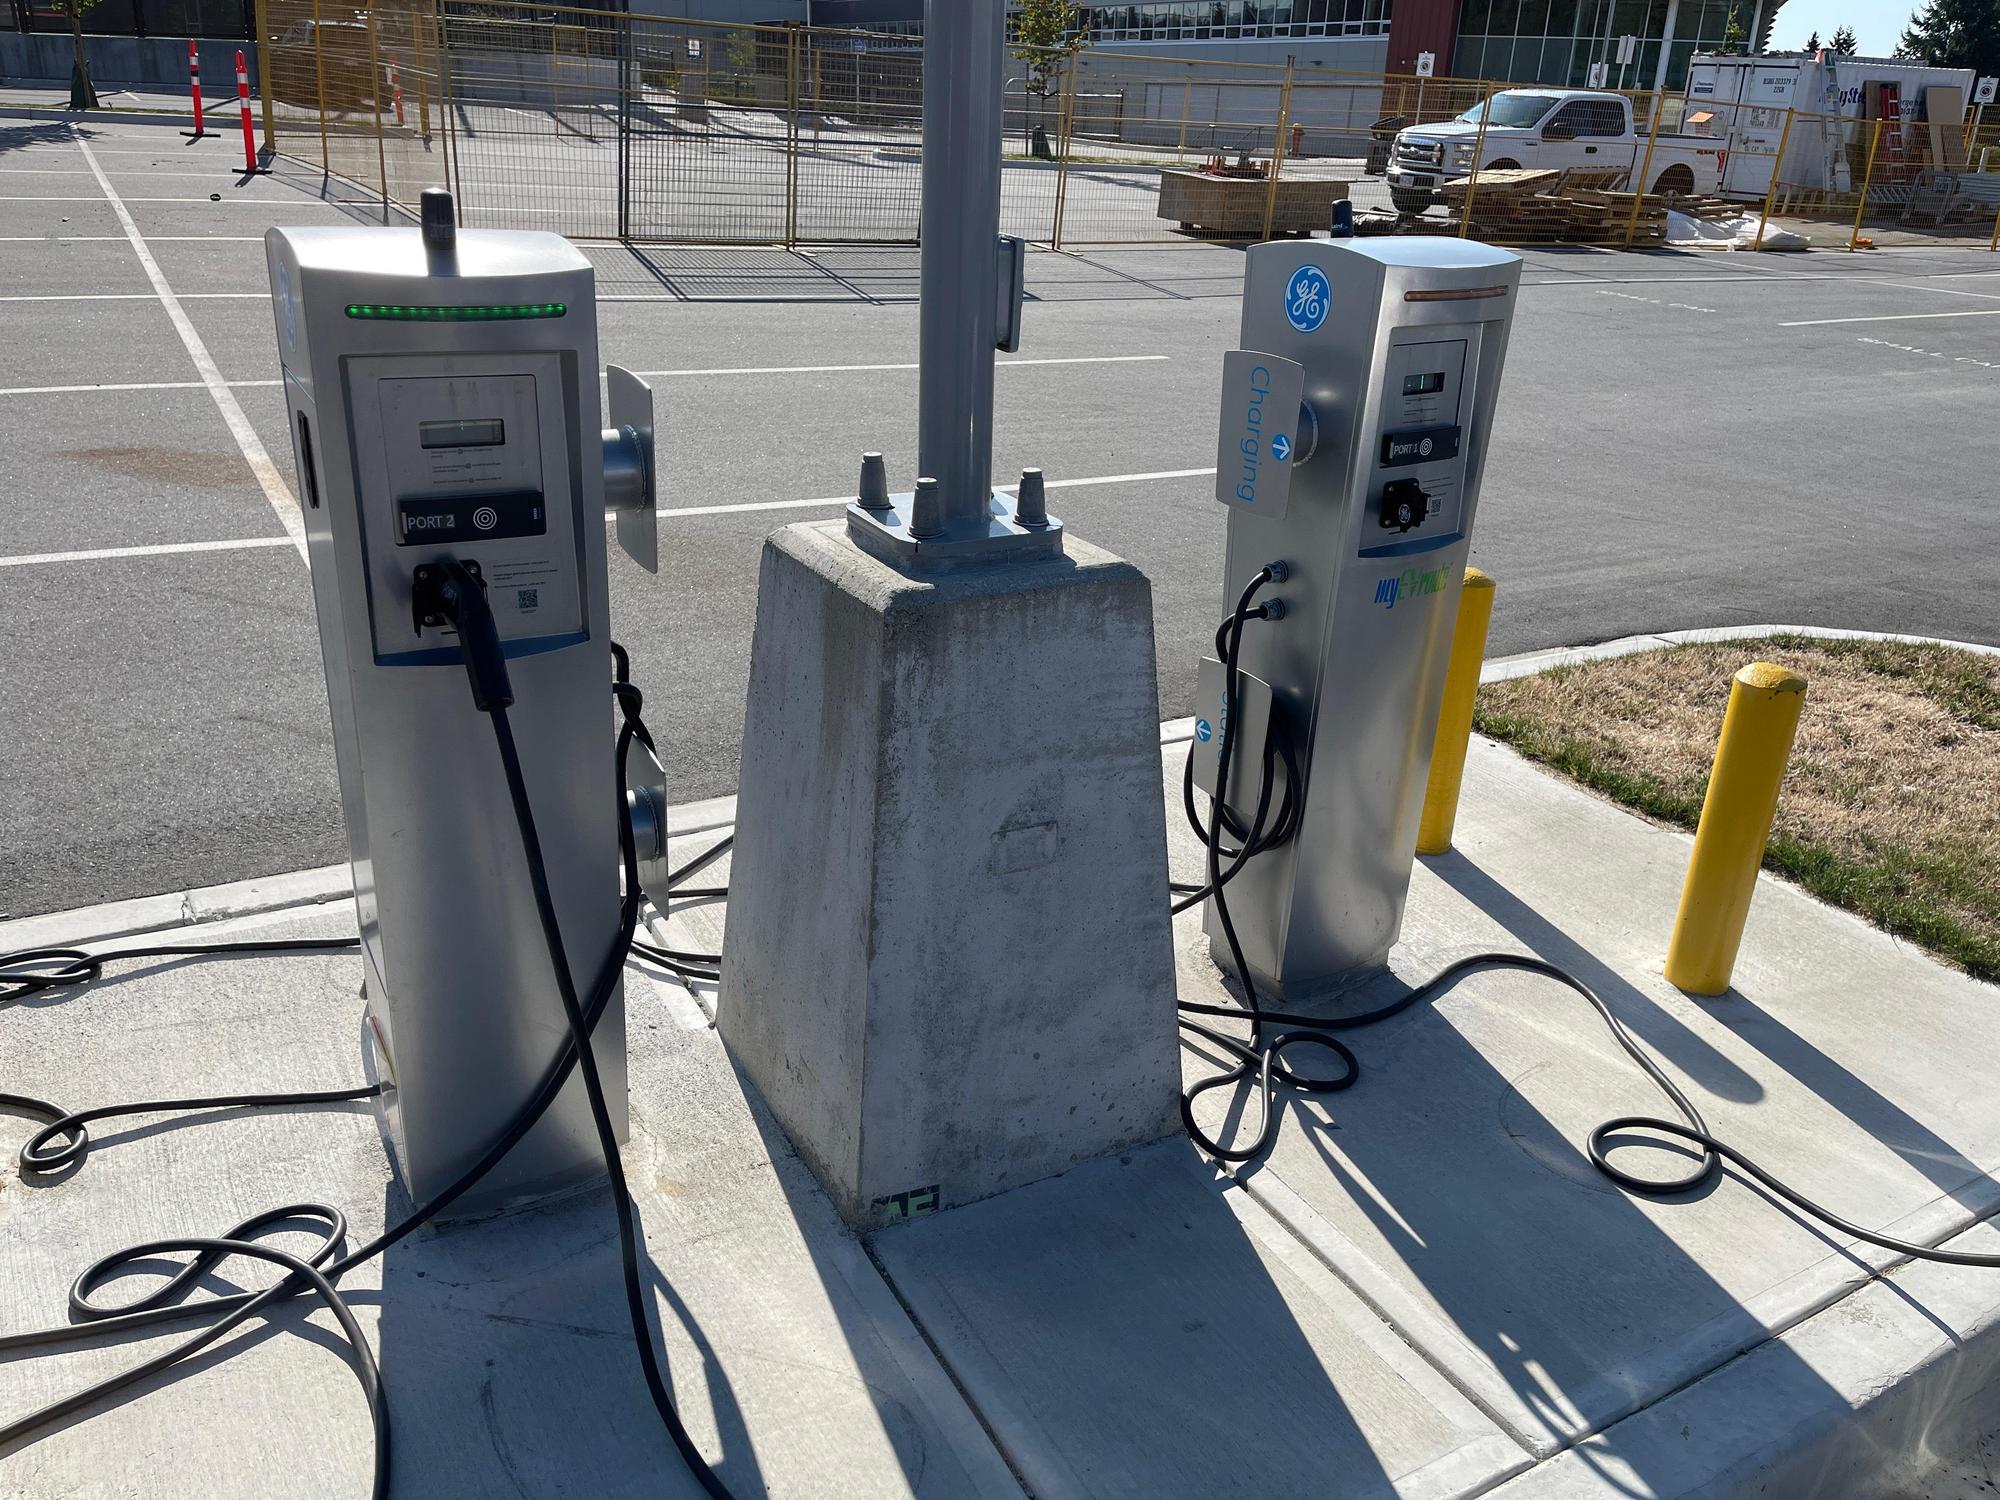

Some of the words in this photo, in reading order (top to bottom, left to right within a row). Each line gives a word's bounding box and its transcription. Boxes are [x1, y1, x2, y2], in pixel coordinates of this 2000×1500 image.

[1237, 366, 1270, 502] Charging
[1393, 443, 1412, 455] PORT
[407, 515, 443, 529] PORT
[446, 514, 456, 528] 2
